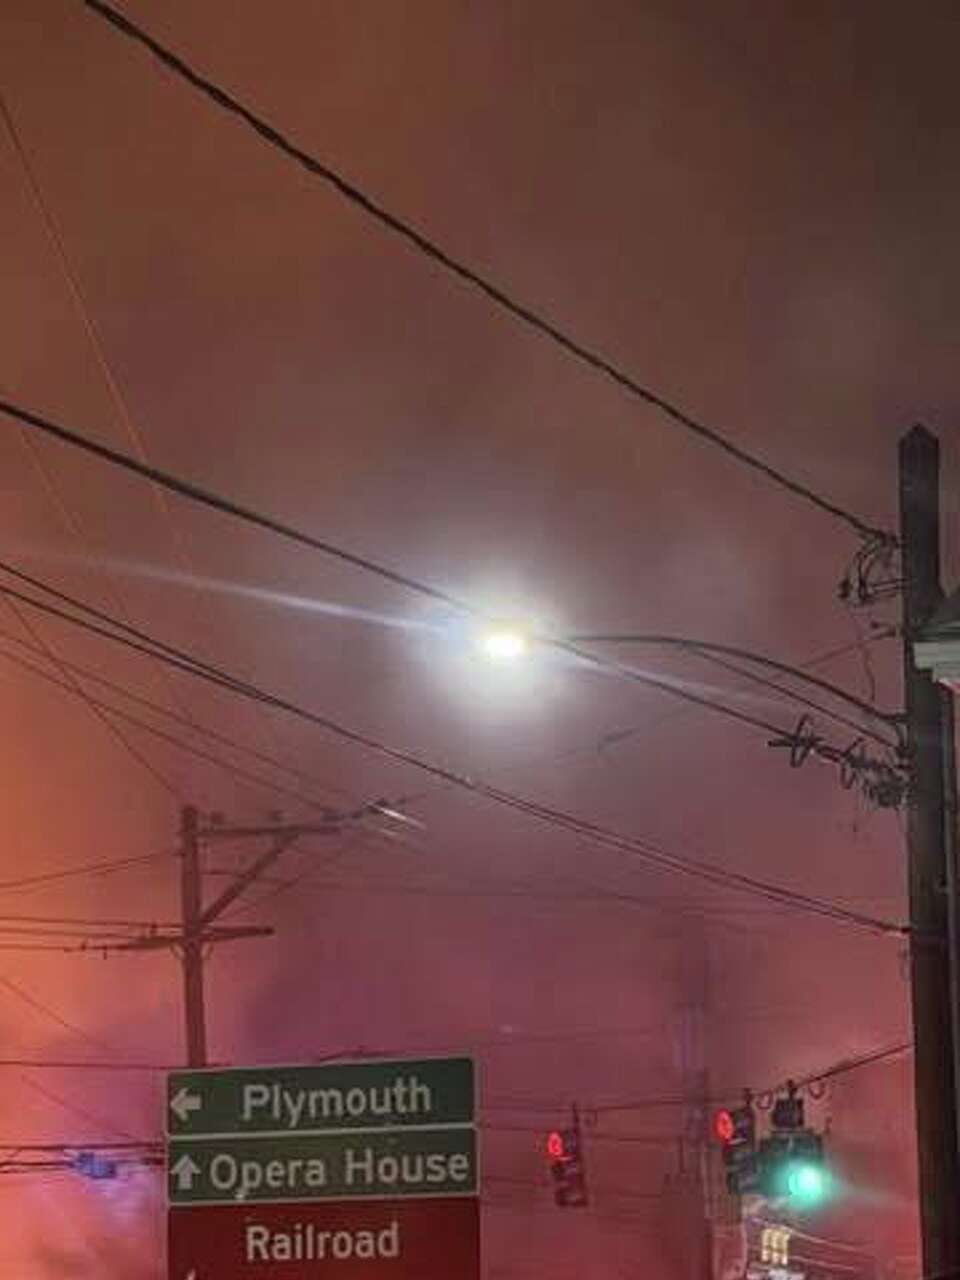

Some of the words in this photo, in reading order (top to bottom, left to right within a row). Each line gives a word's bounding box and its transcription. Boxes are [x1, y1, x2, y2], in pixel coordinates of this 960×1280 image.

[242, 1075, 431, 1128] Plymouth
[209, 1153, 327, 1200] Opera
[344, 1148, 469, 1184] House
[245, 1221, 399, 1260] Railroad
